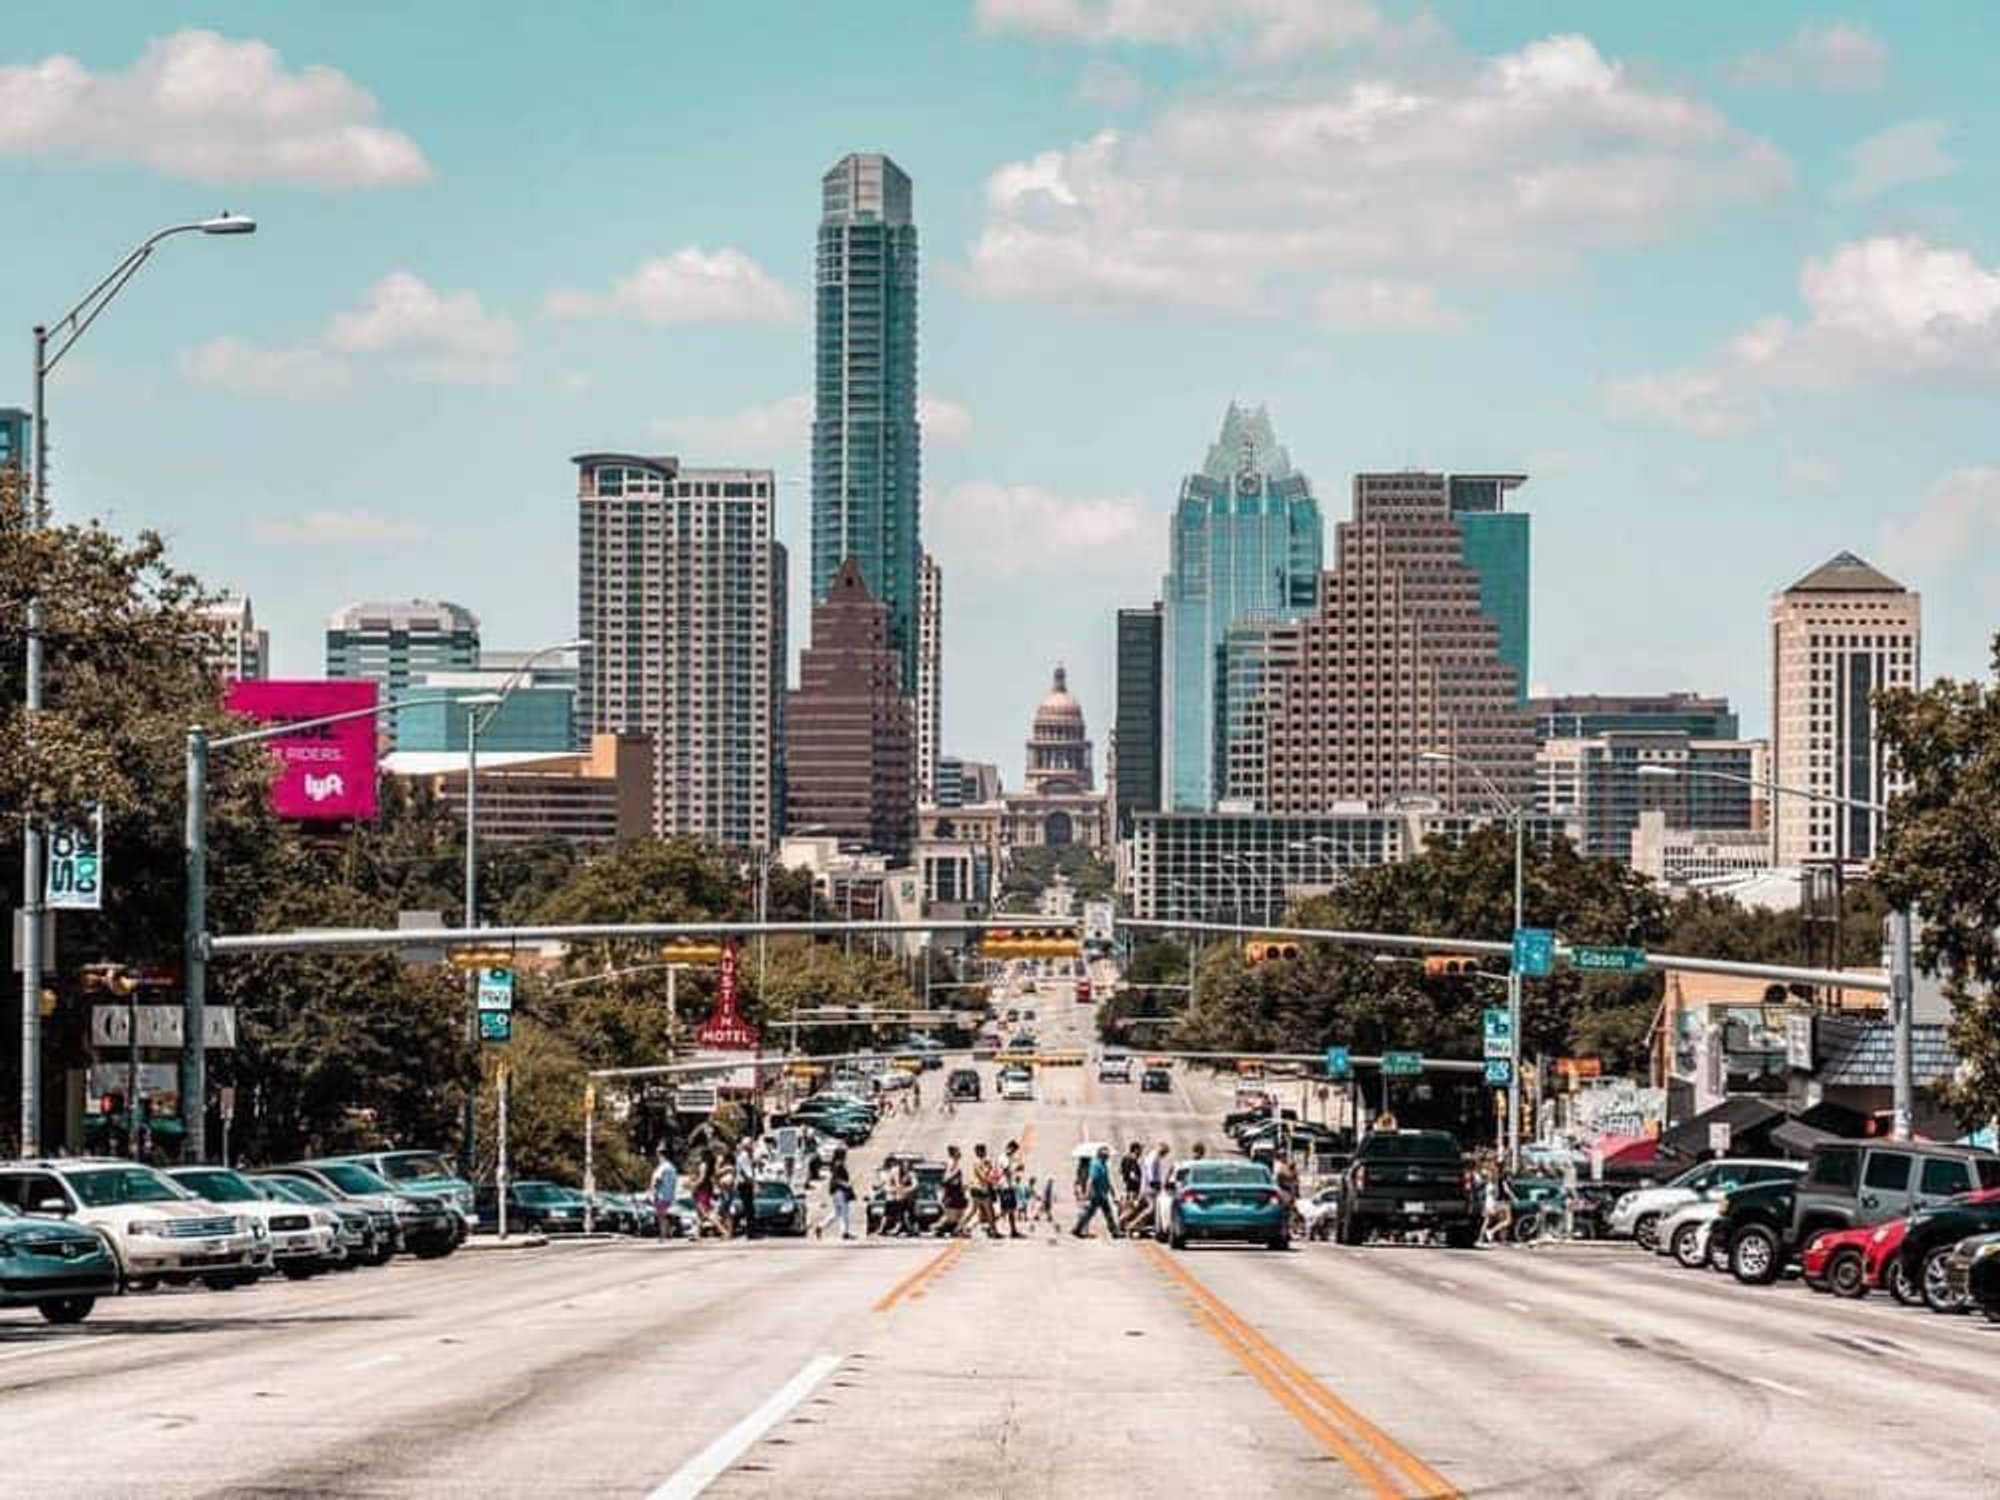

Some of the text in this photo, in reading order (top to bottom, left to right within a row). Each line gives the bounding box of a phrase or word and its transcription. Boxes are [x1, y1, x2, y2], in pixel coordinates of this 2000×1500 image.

[1580, 951, 1626, 967] Gibson
[721, 948, 734, 1027] AUSTIN
[702, 1030, 750, 1043] MOTEL
